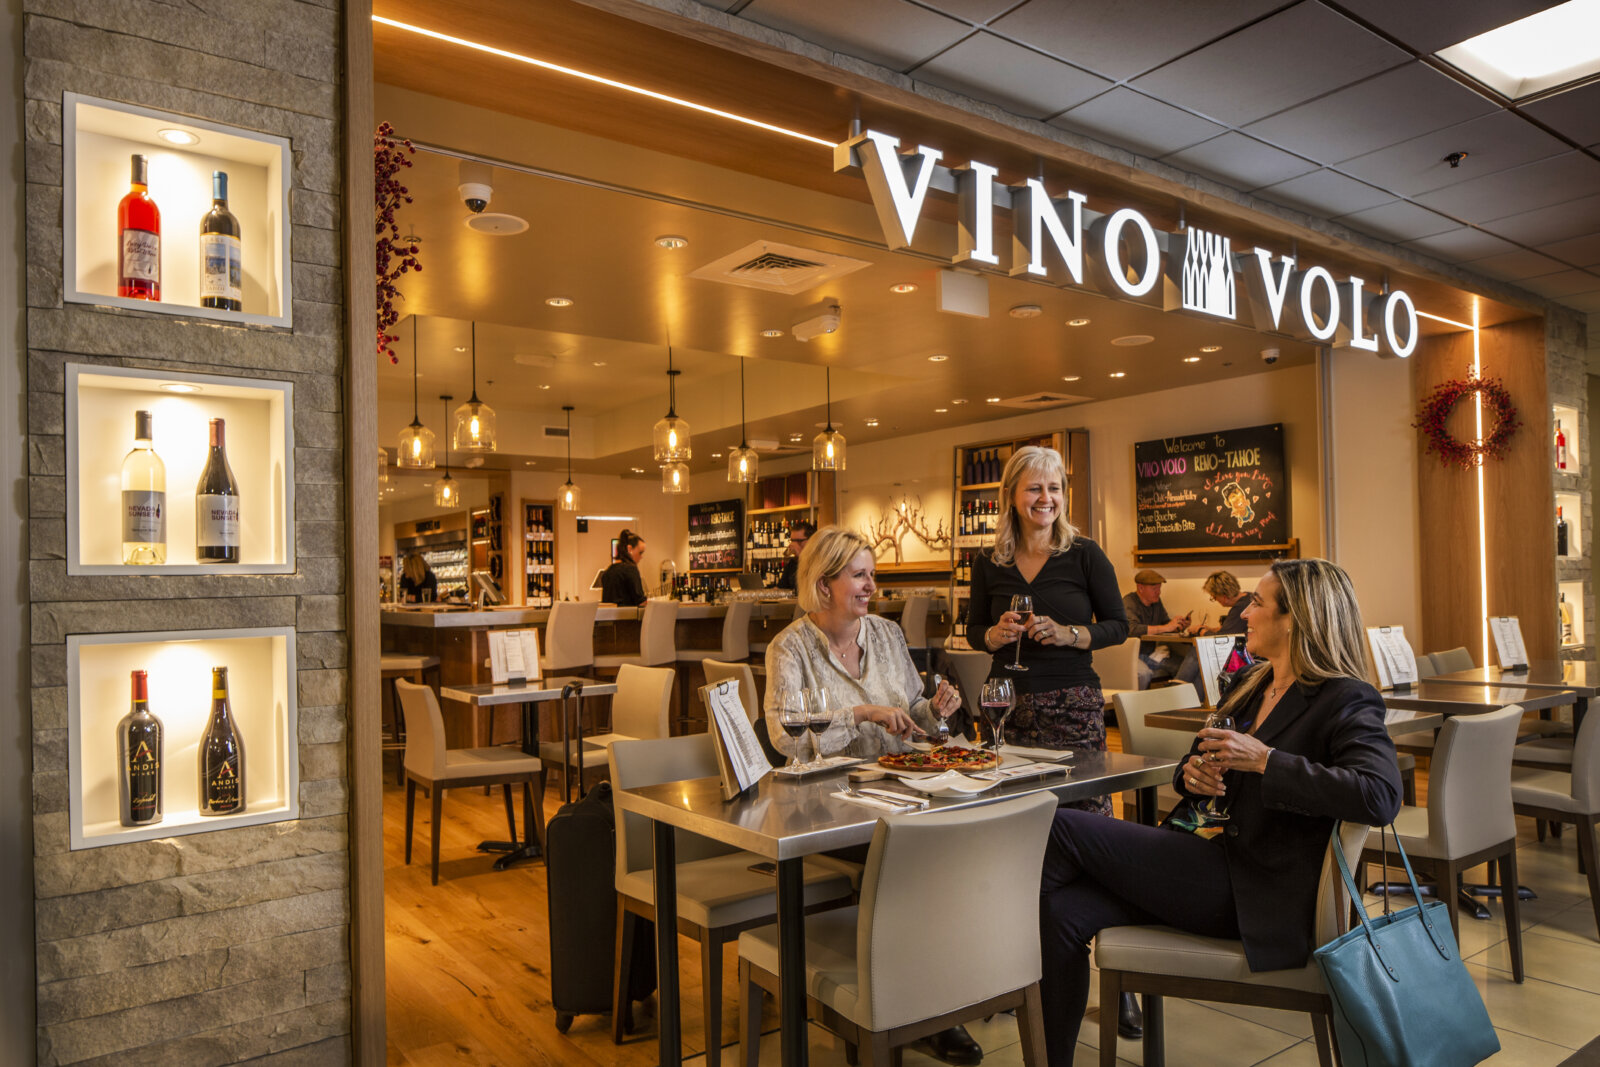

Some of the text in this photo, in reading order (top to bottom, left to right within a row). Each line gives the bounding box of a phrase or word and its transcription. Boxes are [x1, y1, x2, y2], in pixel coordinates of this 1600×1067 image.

[866, 129, 1419, 358] VINO VOLO
[1163, 434, 1226, 454] Welcome to
[1137, 461, 1160, 478] VINO
[1160, 457, 1187, 475] VOLO
[1182, 519, 1196, 531] Bite
[127, 761, 160, 772] ANDIS
[211, 778, 240, 787] ANDIS
